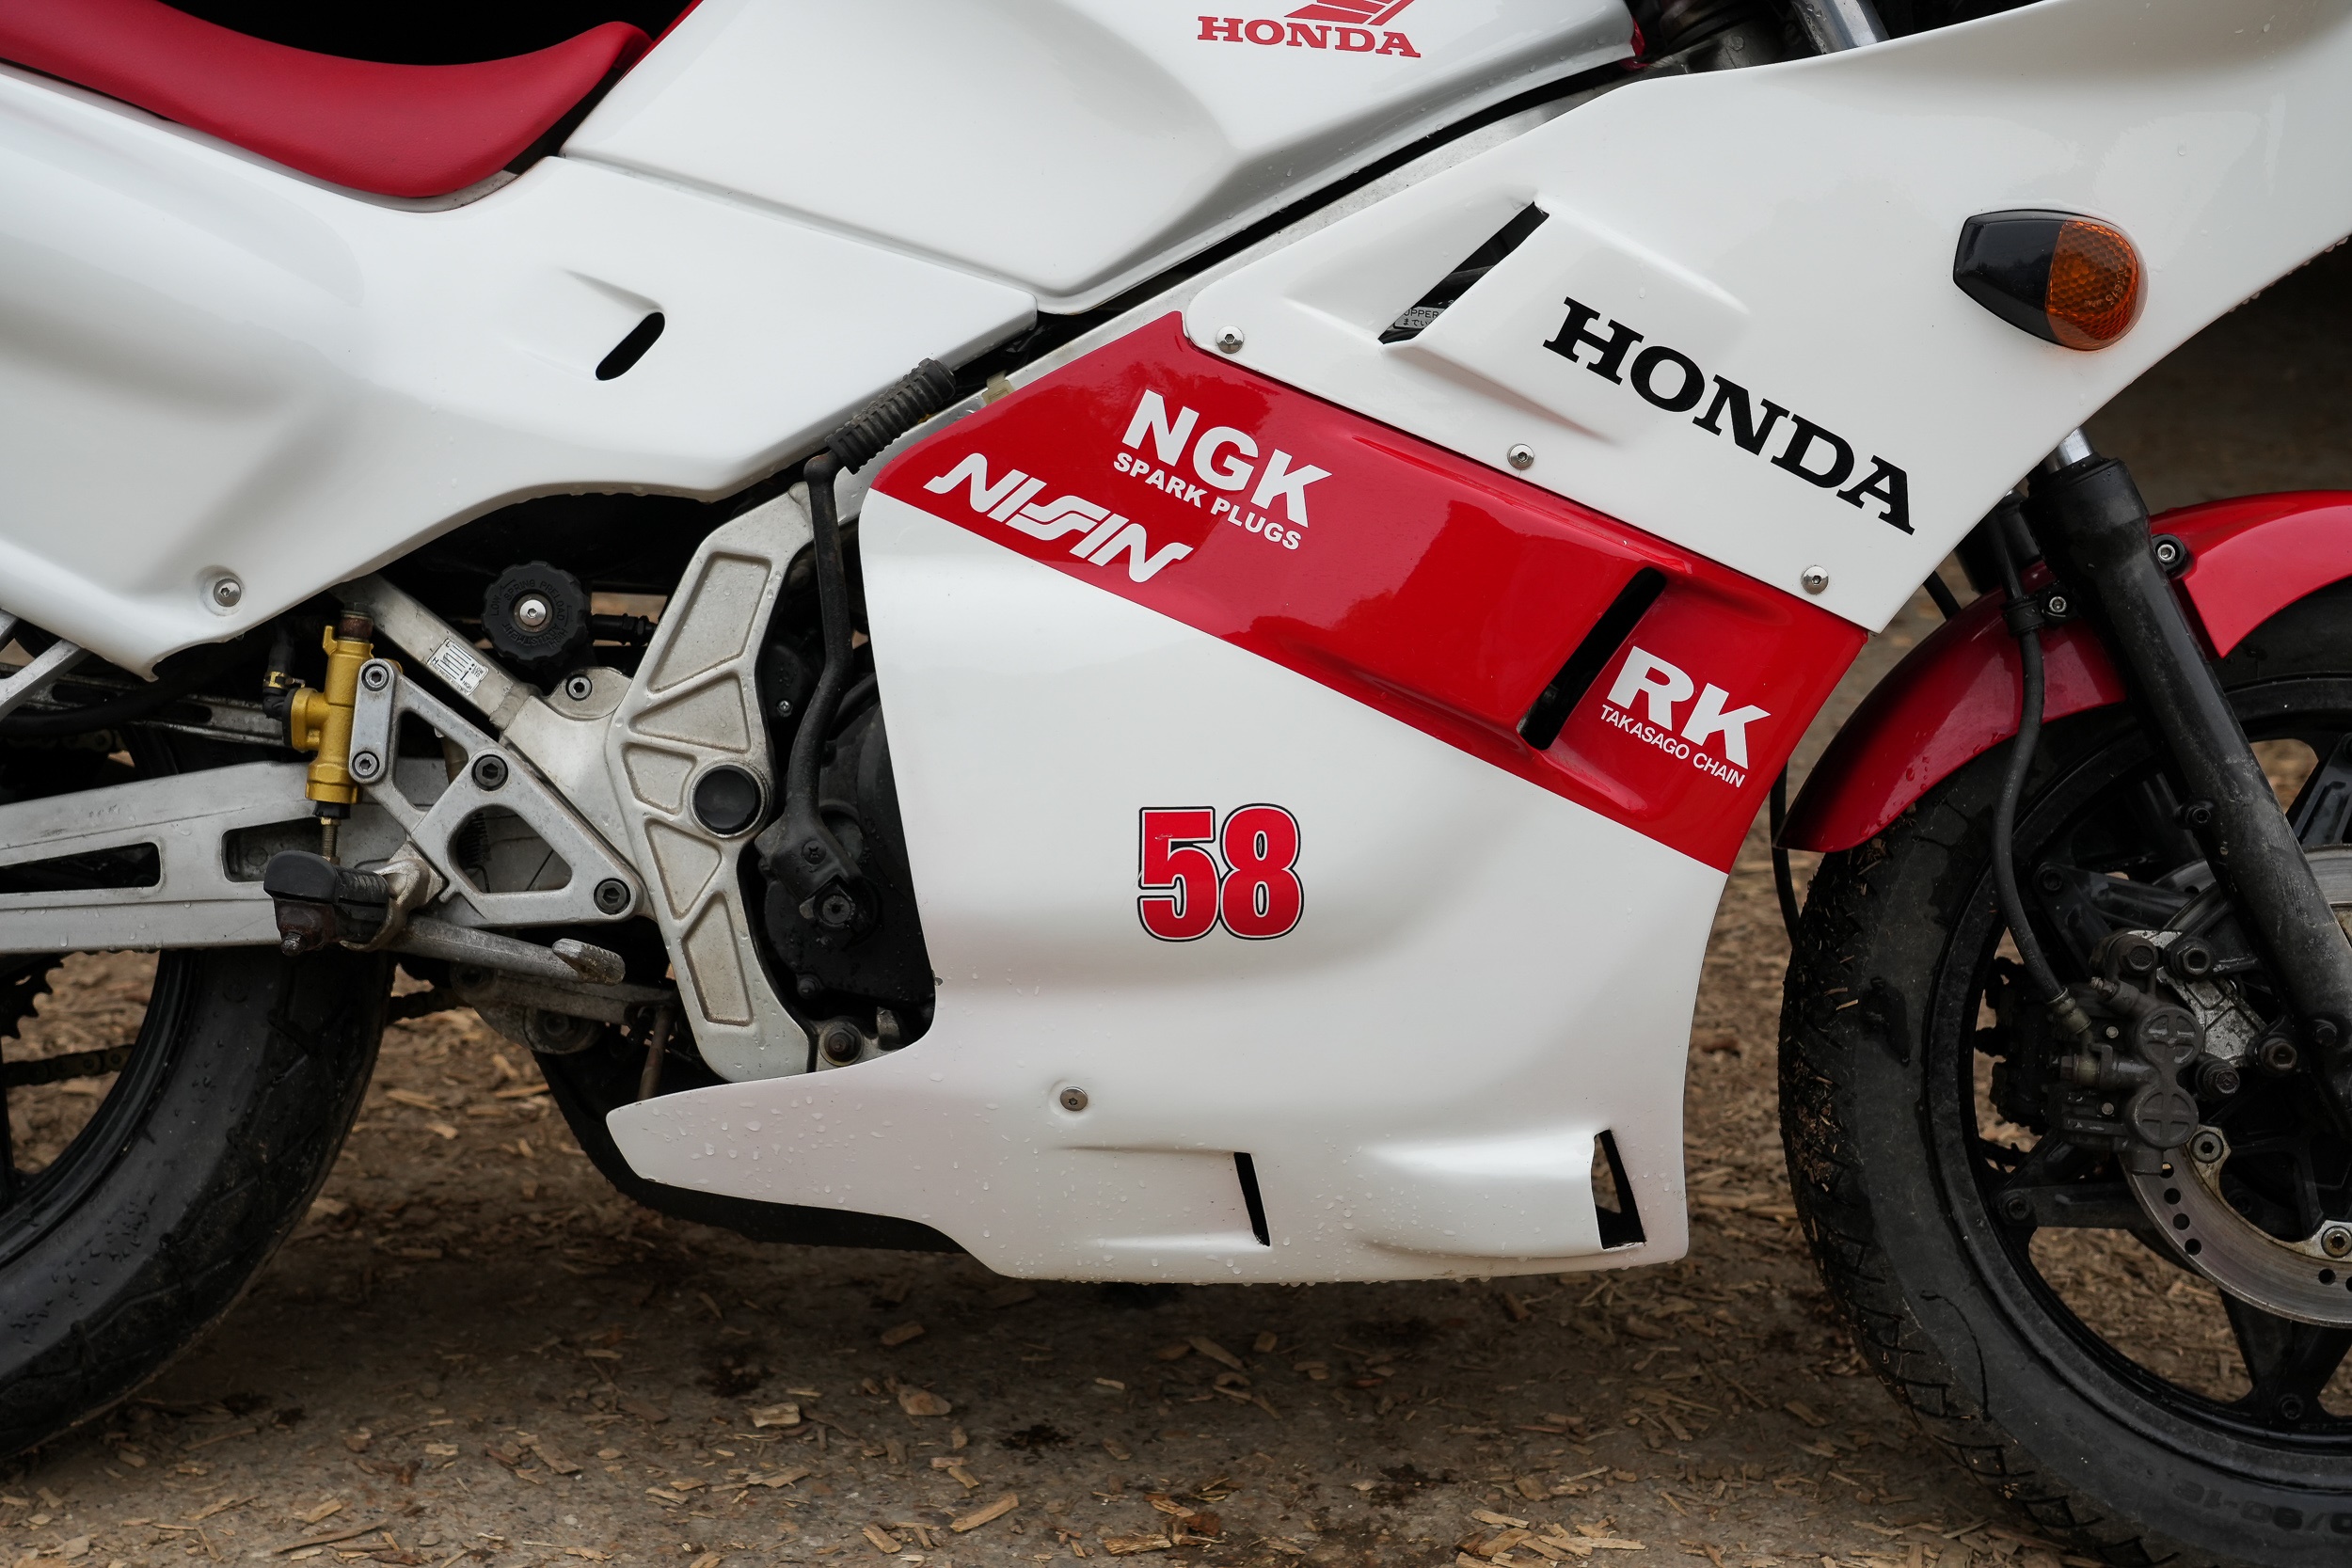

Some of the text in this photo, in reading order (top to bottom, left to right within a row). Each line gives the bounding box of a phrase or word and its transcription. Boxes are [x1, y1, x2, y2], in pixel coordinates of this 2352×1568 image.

[1198, 15, 1422, 58] HONDA
[1404, 308, 1439, 319] UPPER
[1542, 296, 1915, 536] HONDA
[1122, 388, 1333, 529] NGK
[1113, 452, 1302, 550] SPARK PLUGS
[490, 594, 501, 617] LOW
[501, 579, 564, 646] SPRING PRELOAD ADJUSTMENT
[548, 626, 569, 649] HIGH
[1600, 704, 1746, 788] TAKASAGO CHAIN
[1606, 645, 1772, 770] RK
[1136, 802, 1305, 942] 58
